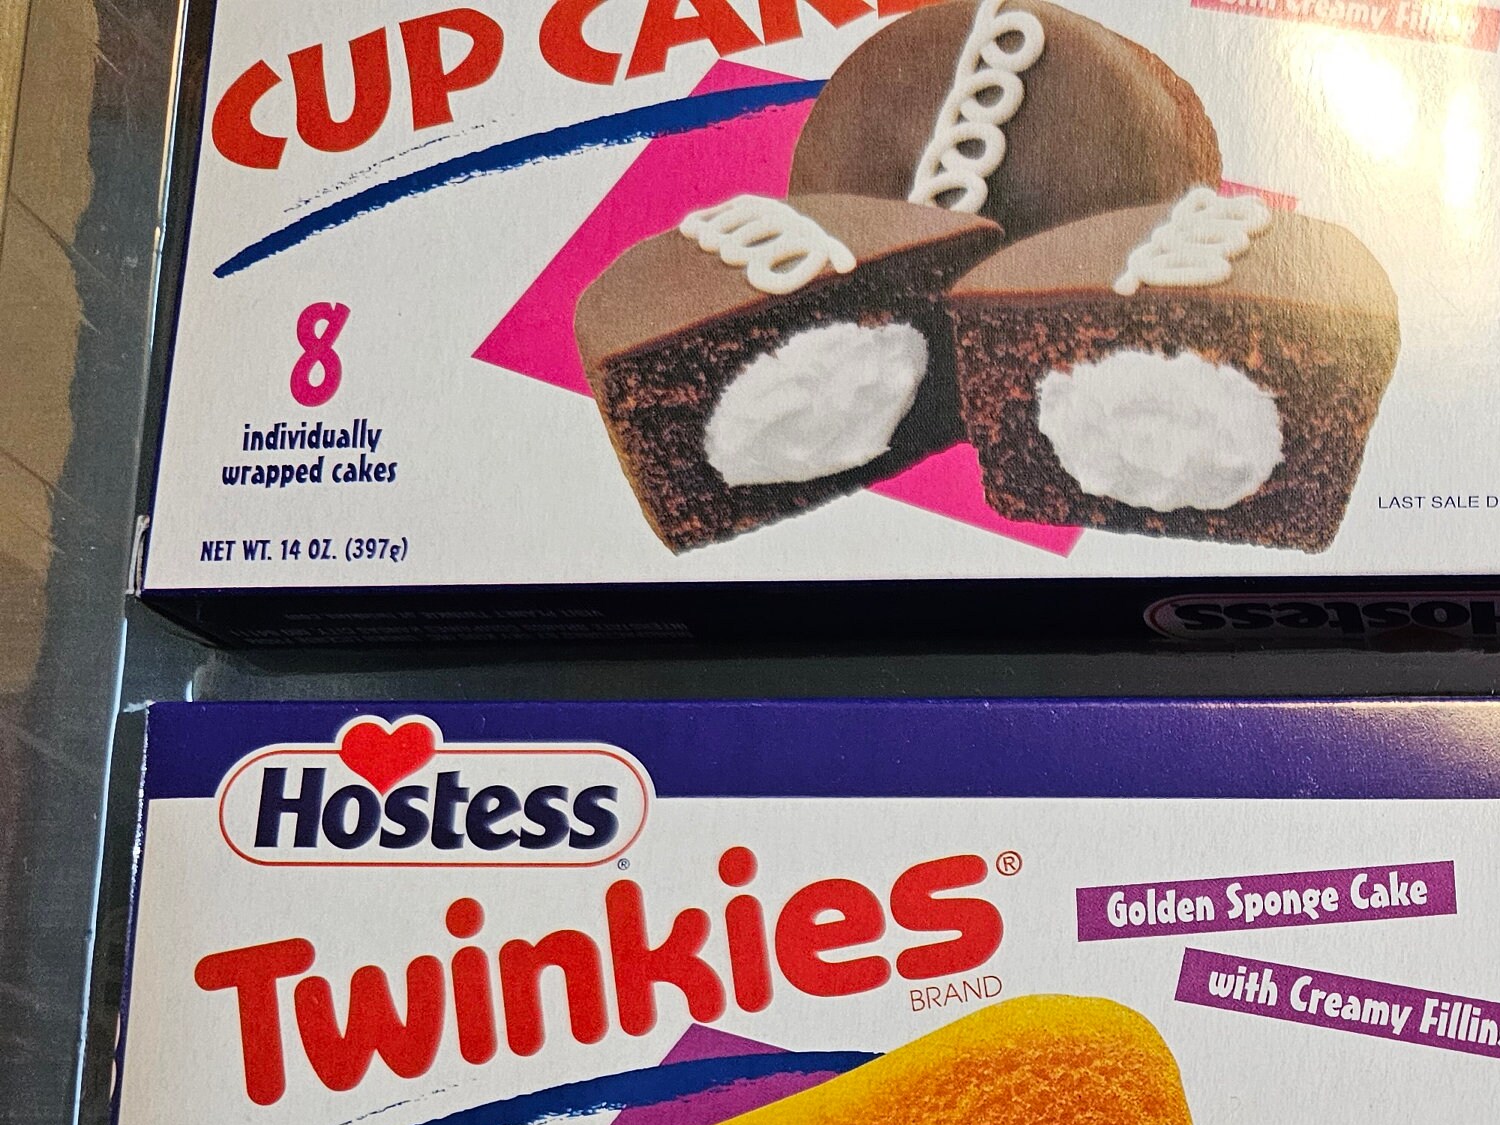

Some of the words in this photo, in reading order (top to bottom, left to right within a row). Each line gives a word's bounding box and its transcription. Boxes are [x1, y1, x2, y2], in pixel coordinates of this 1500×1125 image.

[212, 7, 504, 170] CUP
[290, 301, 351, 407] 8
[242, 418, 382, 452] individually
[222, 456, 324, 488] wrapped
[332, 453, 397, 483] cakes
[1378, 497, 1427, 510] LAST
[1431, 496, 1482, 510] SALE
[200, 540, 236, 561] NET
[243, 540, 272, 560] WT.
[281, 539, 301, 560] 14
[308, 539, 336, 560] OZ.
[345, 537, 408, 562] (397g)
[254, 767, 619, 850] Hostess
[1107, 888, 1215, 928] Golden
[1227, 882, 1339, 922] Sponge
[1350, 872, 1428, 910] Cake
[194, 846, 1004, 1106] Twinkies
[909, 976, 1003, 1013] BRAND
[1208, 966, 1278, 1007] with
[1290, 976, 1414, 1035] Creamy
